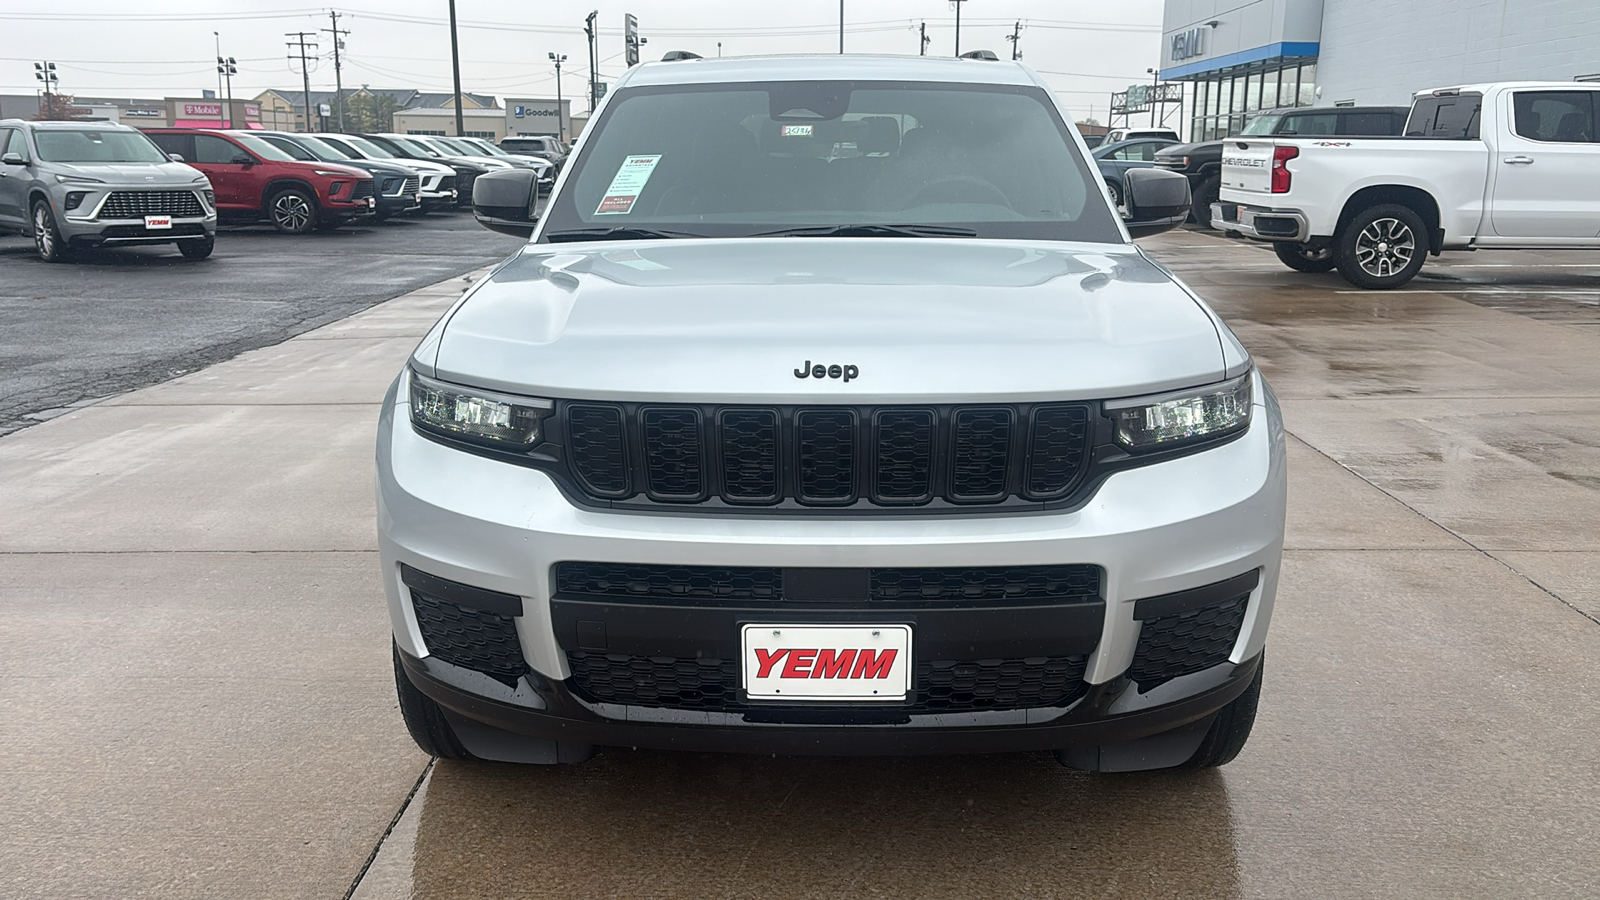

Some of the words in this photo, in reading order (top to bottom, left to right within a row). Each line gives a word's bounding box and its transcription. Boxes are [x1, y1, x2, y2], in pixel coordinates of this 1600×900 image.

[194, 105, 219, 115] Mobile
[1221, 157, 1267, 167] CHEVROLET
[794, 360, 859, 383] Jeep
[754, 648, 899, 679] YEMM
